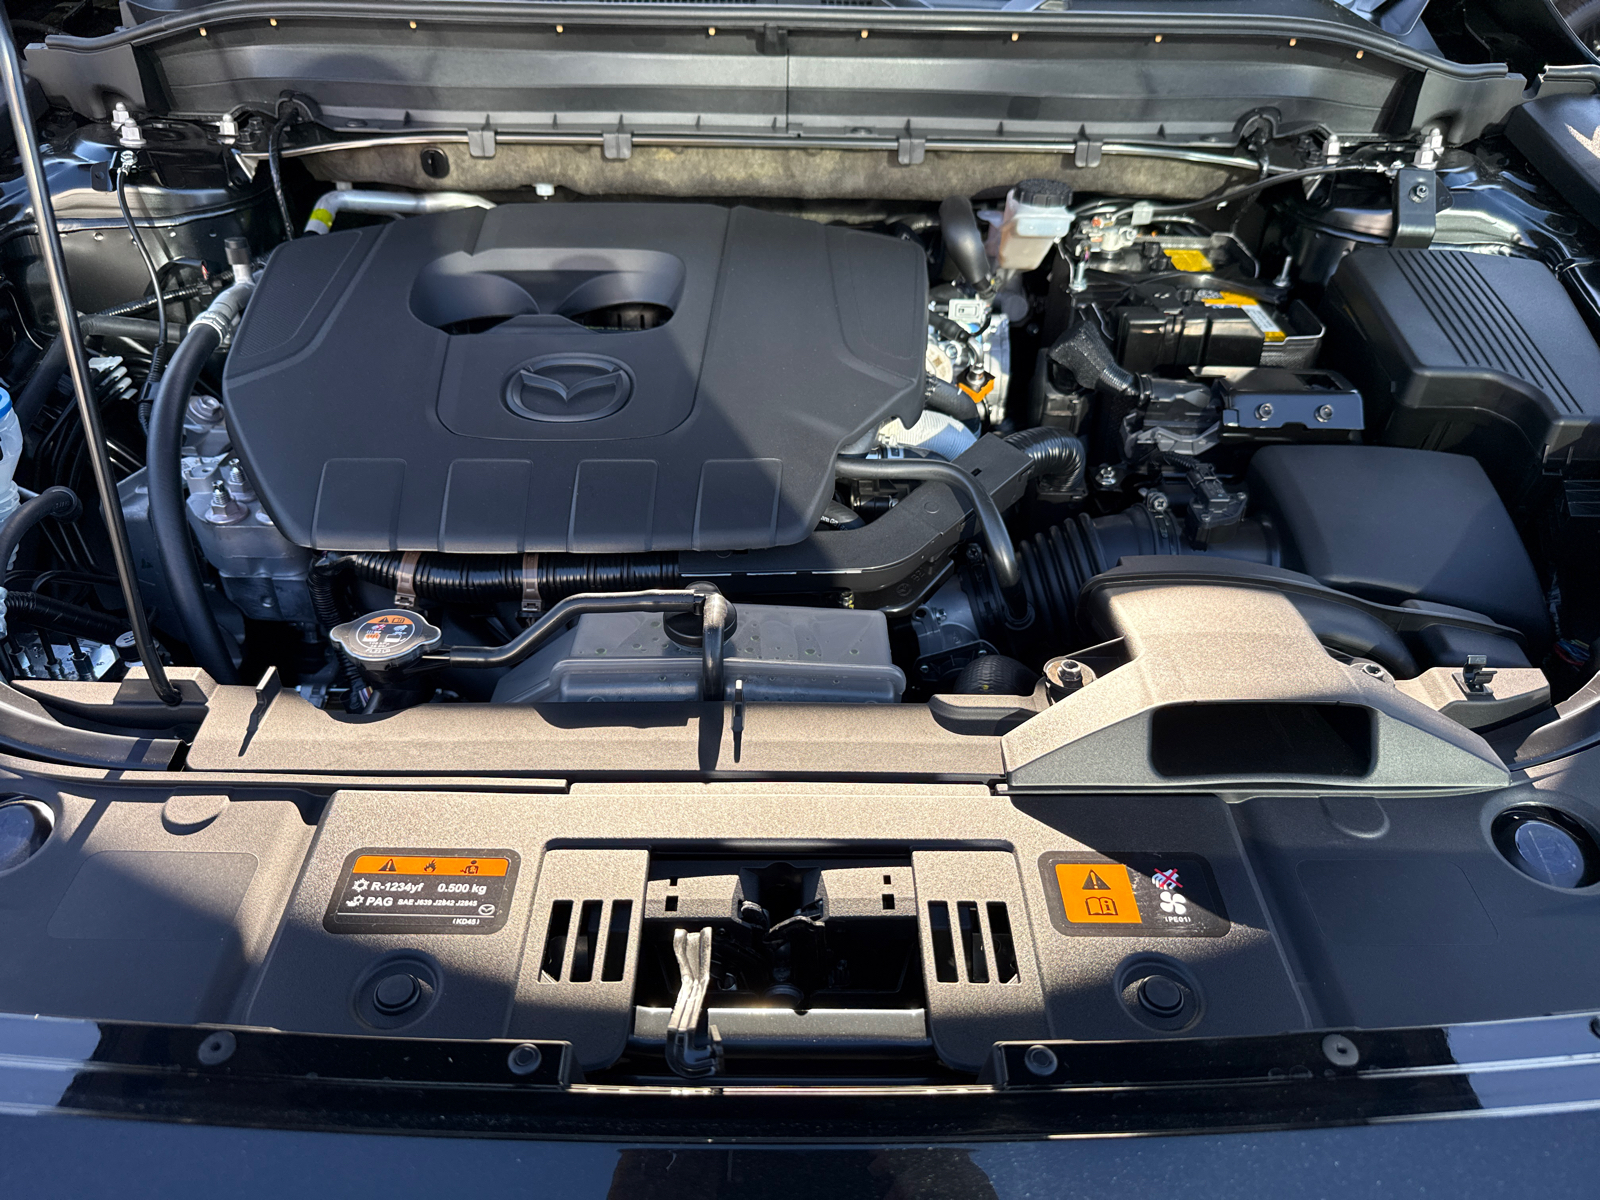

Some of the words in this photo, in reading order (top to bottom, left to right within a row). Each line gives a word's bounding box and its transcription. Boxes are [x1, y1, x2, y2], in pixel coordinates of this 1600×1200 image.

[370, 881, 424, 894] R-1234yf
[437, 883, 469, 893] 0.500
[471, 883, 487, 895] kg
[365, 896, 394, 907] PAG
[397, 898, 414, 906] SAE
